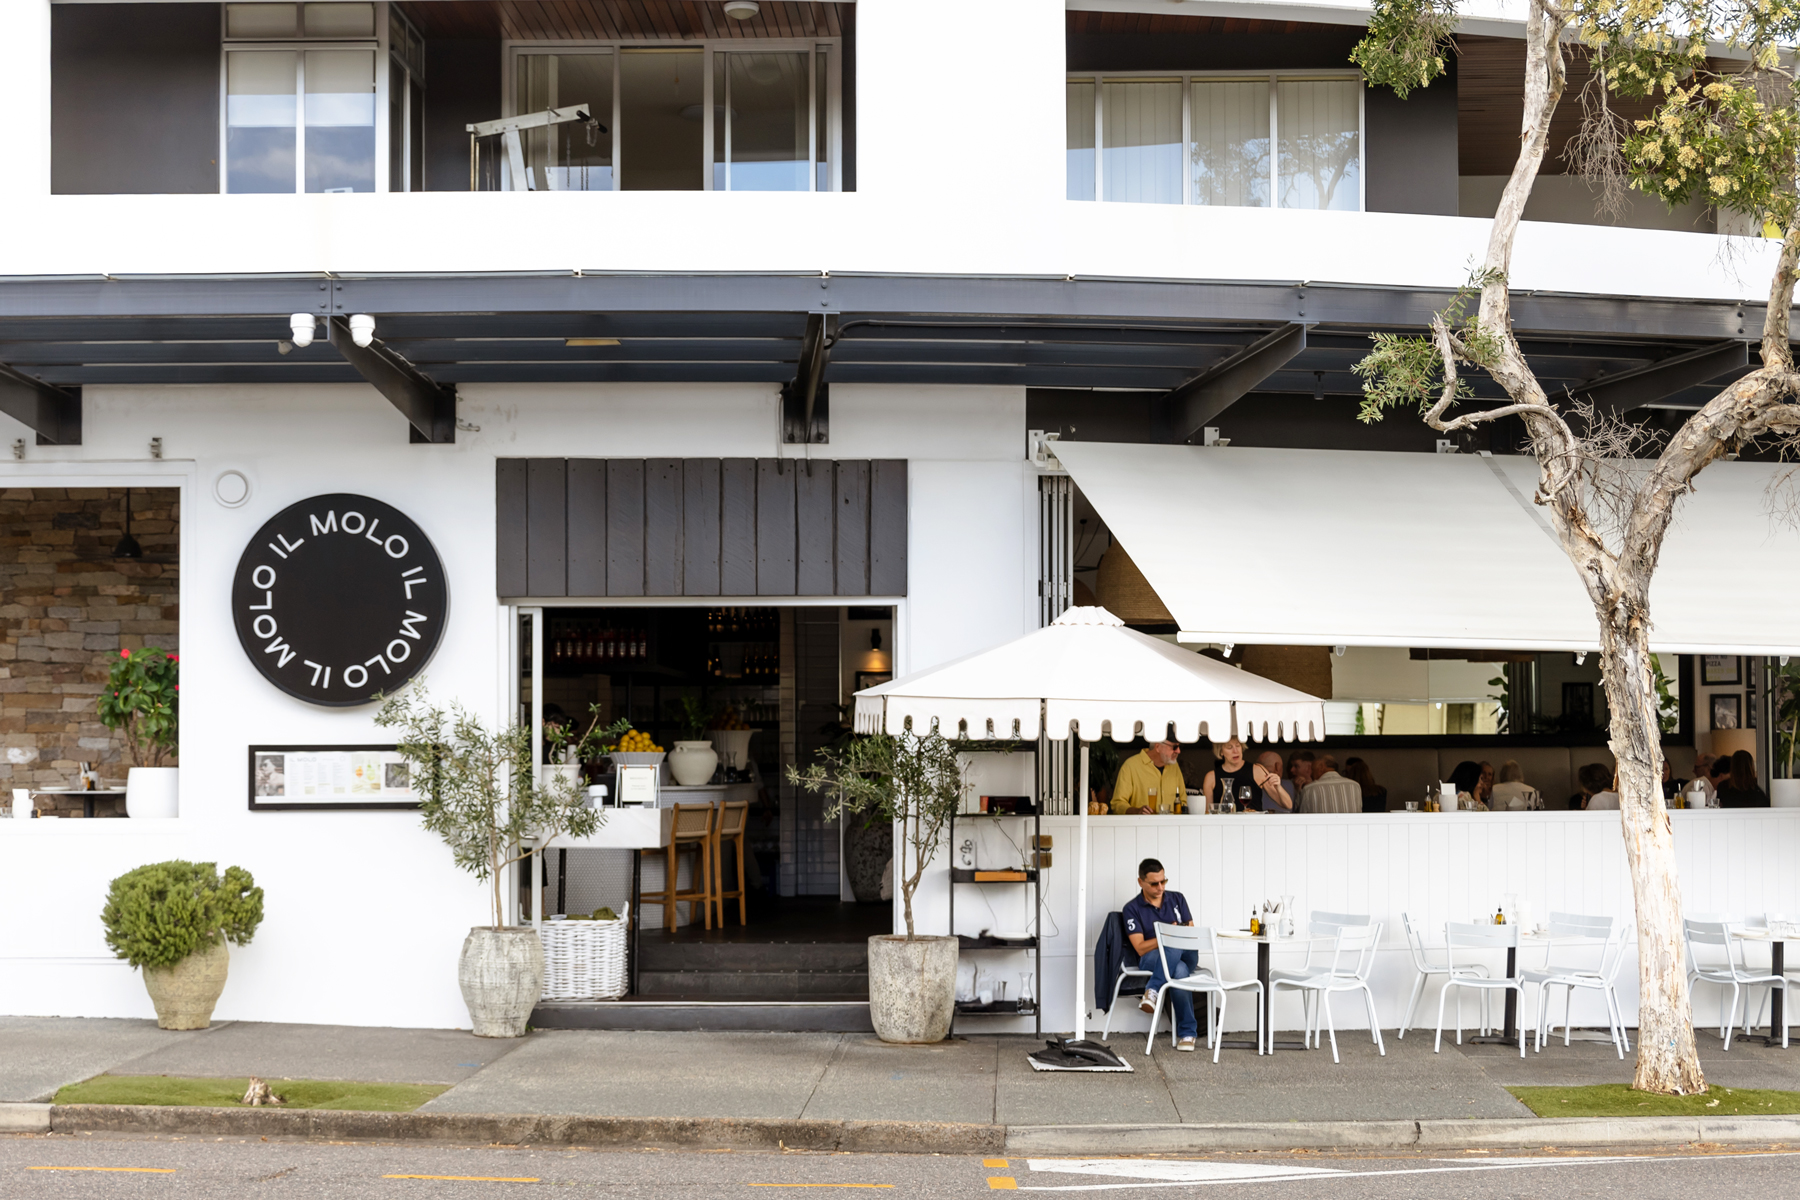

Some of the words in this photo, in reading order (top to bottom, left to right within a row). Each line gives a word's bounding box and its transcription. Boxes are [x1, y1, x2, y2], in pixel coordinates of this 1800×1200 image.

[269, 534, 304, 559] IL
[309, 510, 409, 559] MOLO
[402, 566, 427, 600] IL
[249, 565, 297, 669] MOLO
[343, 609, 427, 688] MOLO
[304, 660, 331, 689] IL
[1127, 918, 1136, 931] 3
